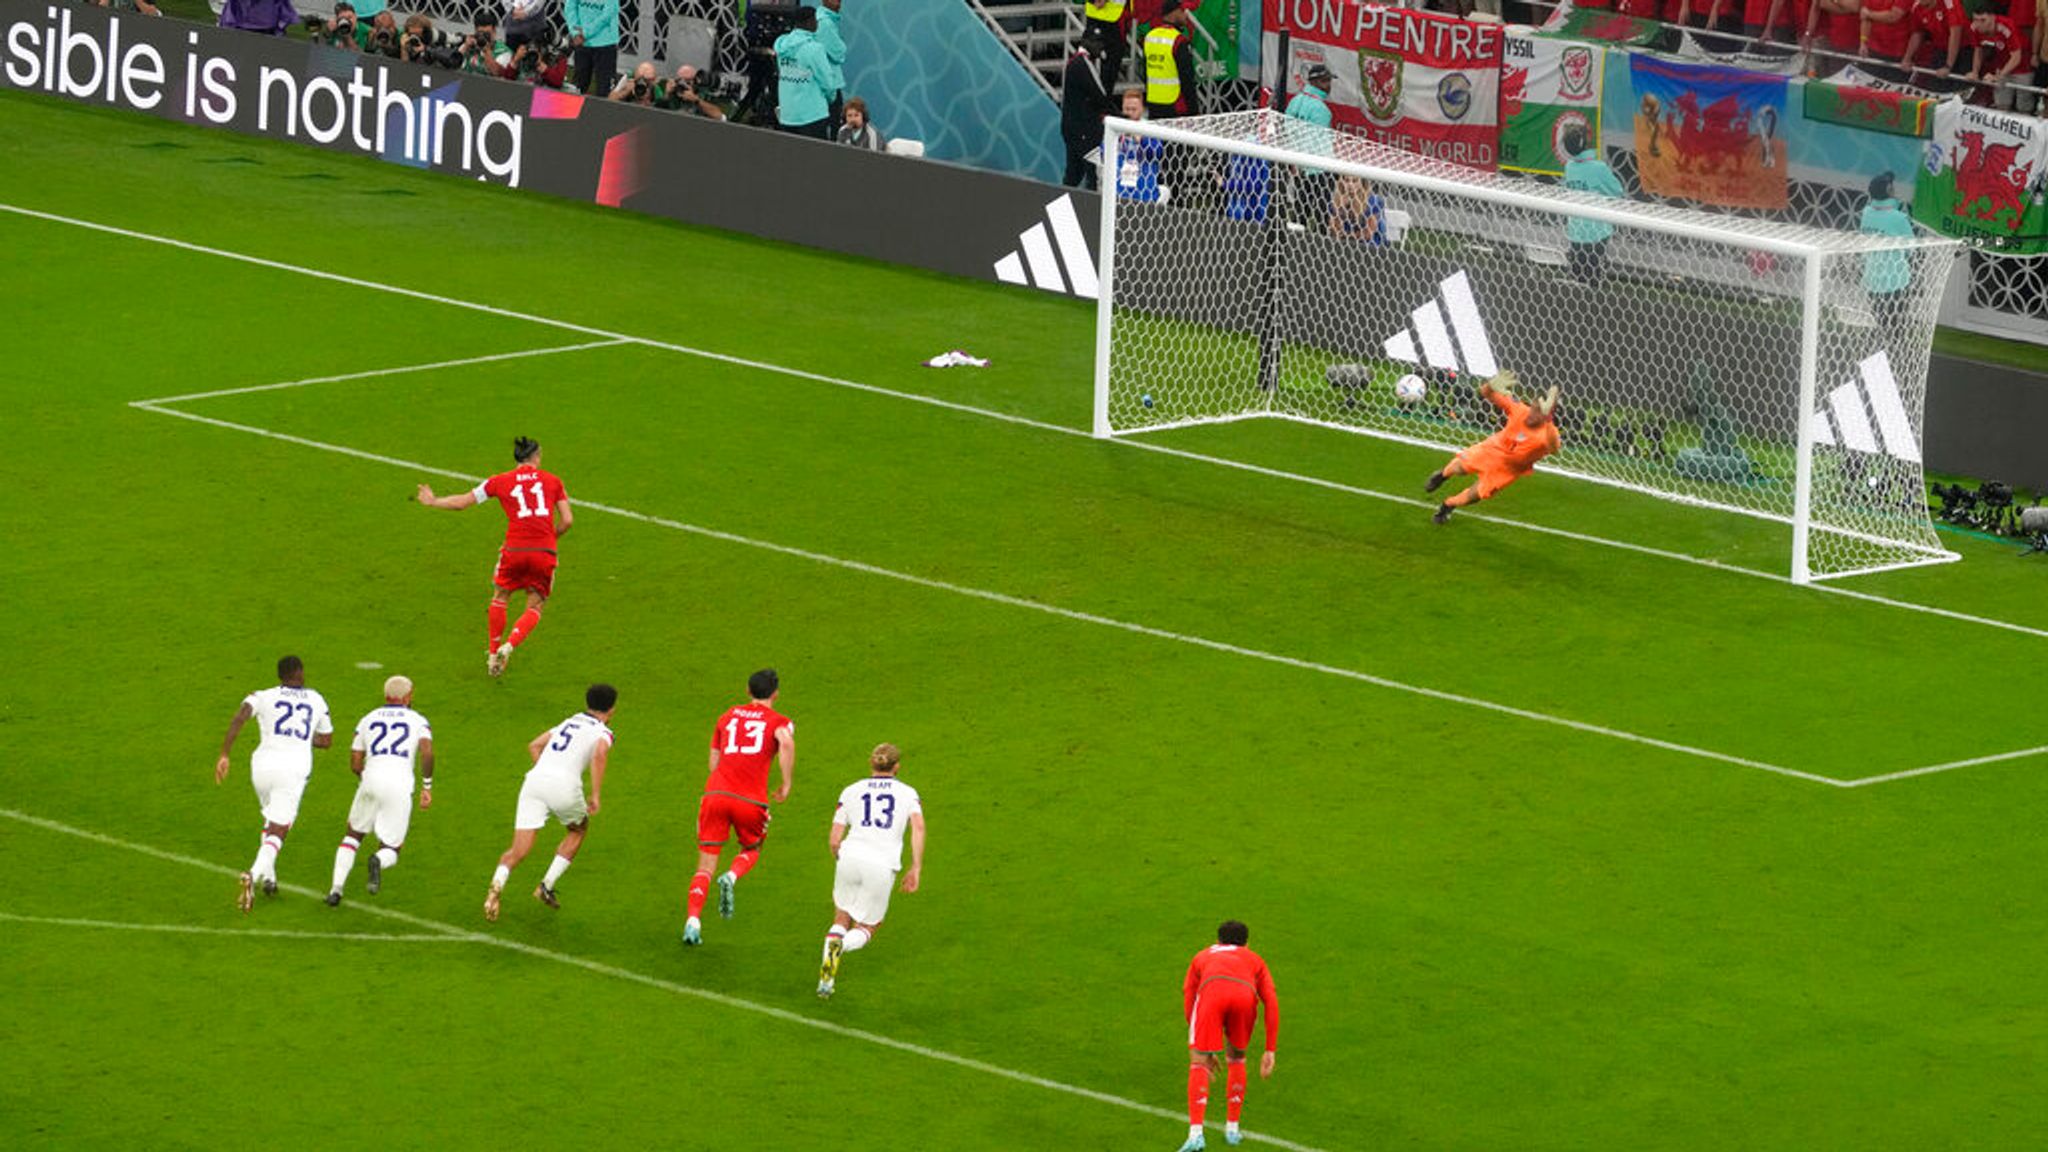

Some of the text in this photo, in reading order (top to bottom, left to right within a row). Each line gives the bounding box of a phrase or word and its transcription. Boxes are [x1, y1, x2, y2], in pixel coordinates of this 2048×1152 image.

[1354, 6, 1497, 60] PENTRE
[185, 32, 236, 124] is
[258, 66, 523, 188] nothing
[1418, 137, 1492, 164] WORLD
[509, 481, 550, 518] 11
[274, 700, 314, 741] 23
[552, 723, 580, 752] 5
[723, 718, 768, 755] 13
[368, 721, 410, 758] 22
[860, 792, 896, 830] 13
